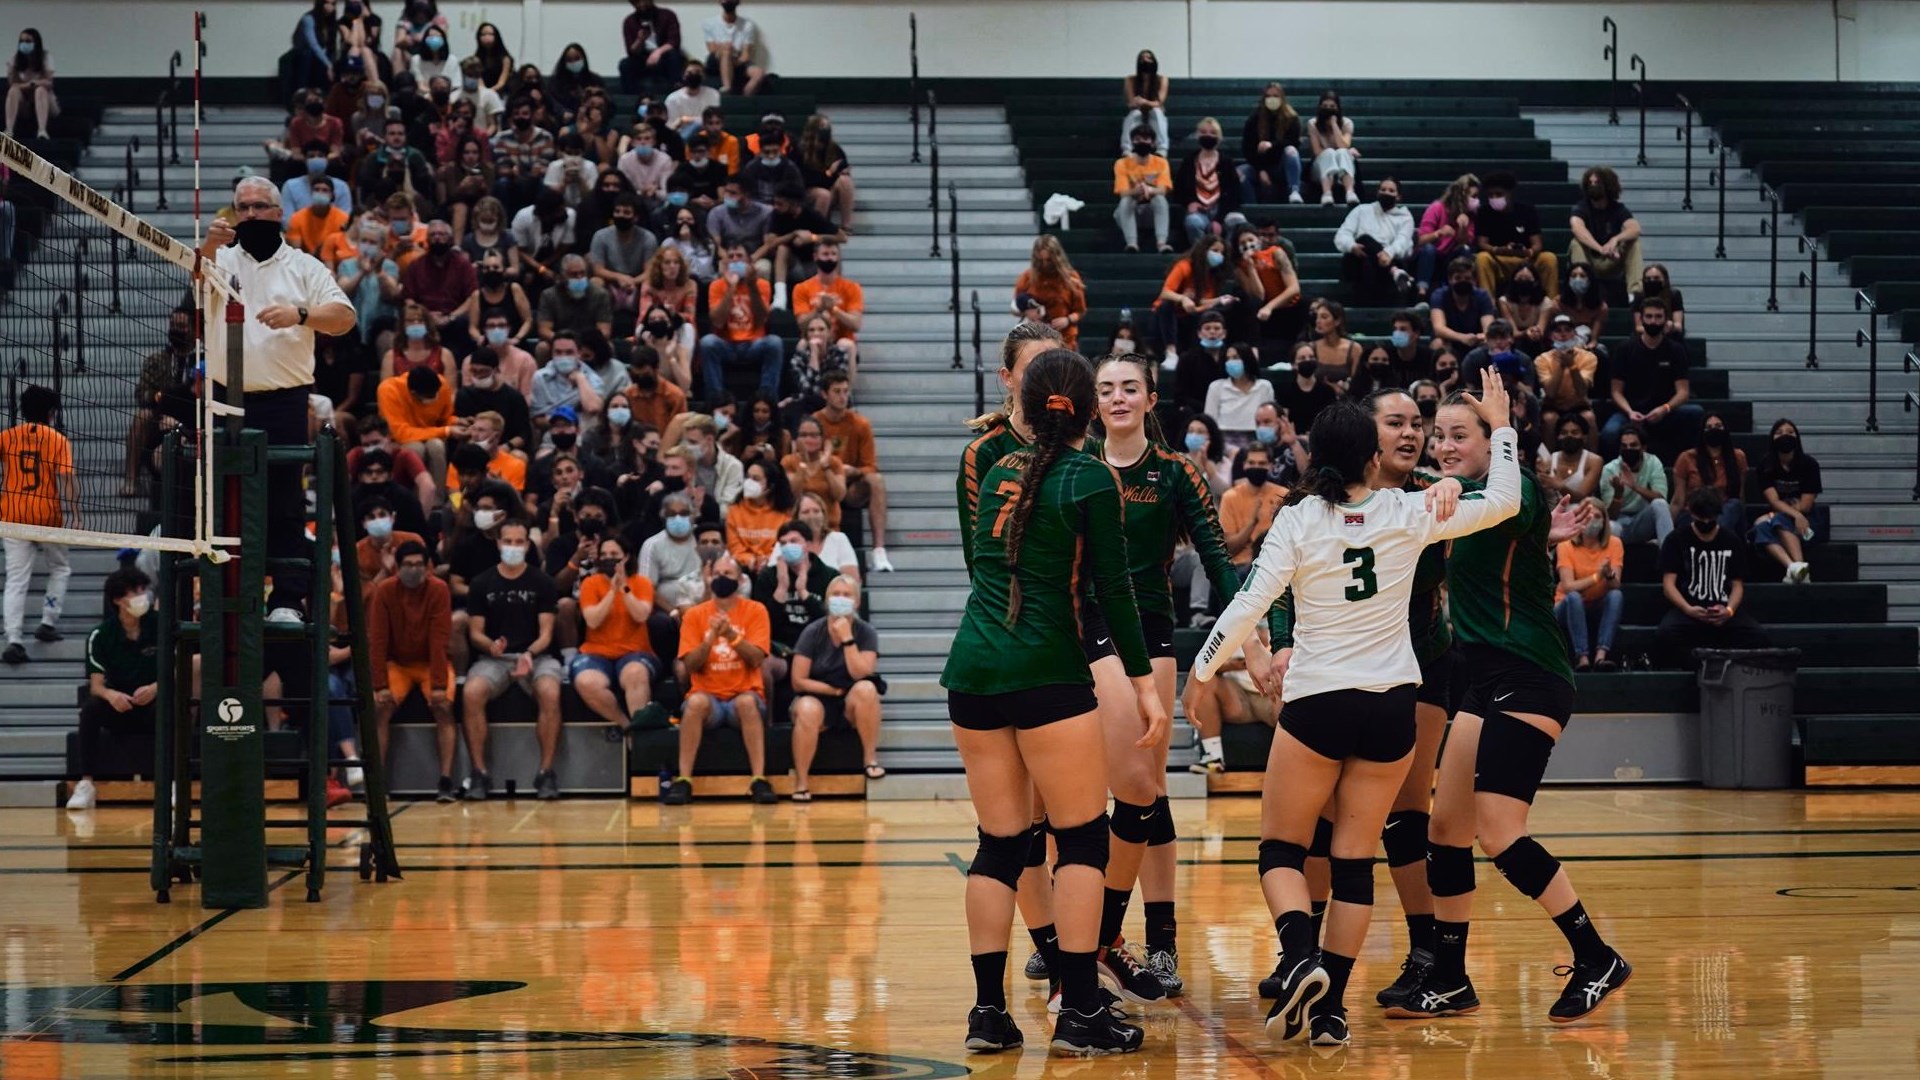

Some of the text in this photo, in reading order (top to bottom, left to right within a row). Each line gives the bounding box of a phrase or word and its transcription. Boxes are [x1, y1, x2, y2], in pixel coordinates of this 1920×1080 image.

[1502, 441, 1513, 462] WWU
[20, 450, 41, 491] 9
[991, 480, 1023, 538] 7
[1122, 485, 1159, 503] Walla
[1343, 546, 1378, 602] 3
[1203, 630, 1226, 664] WOLVES
